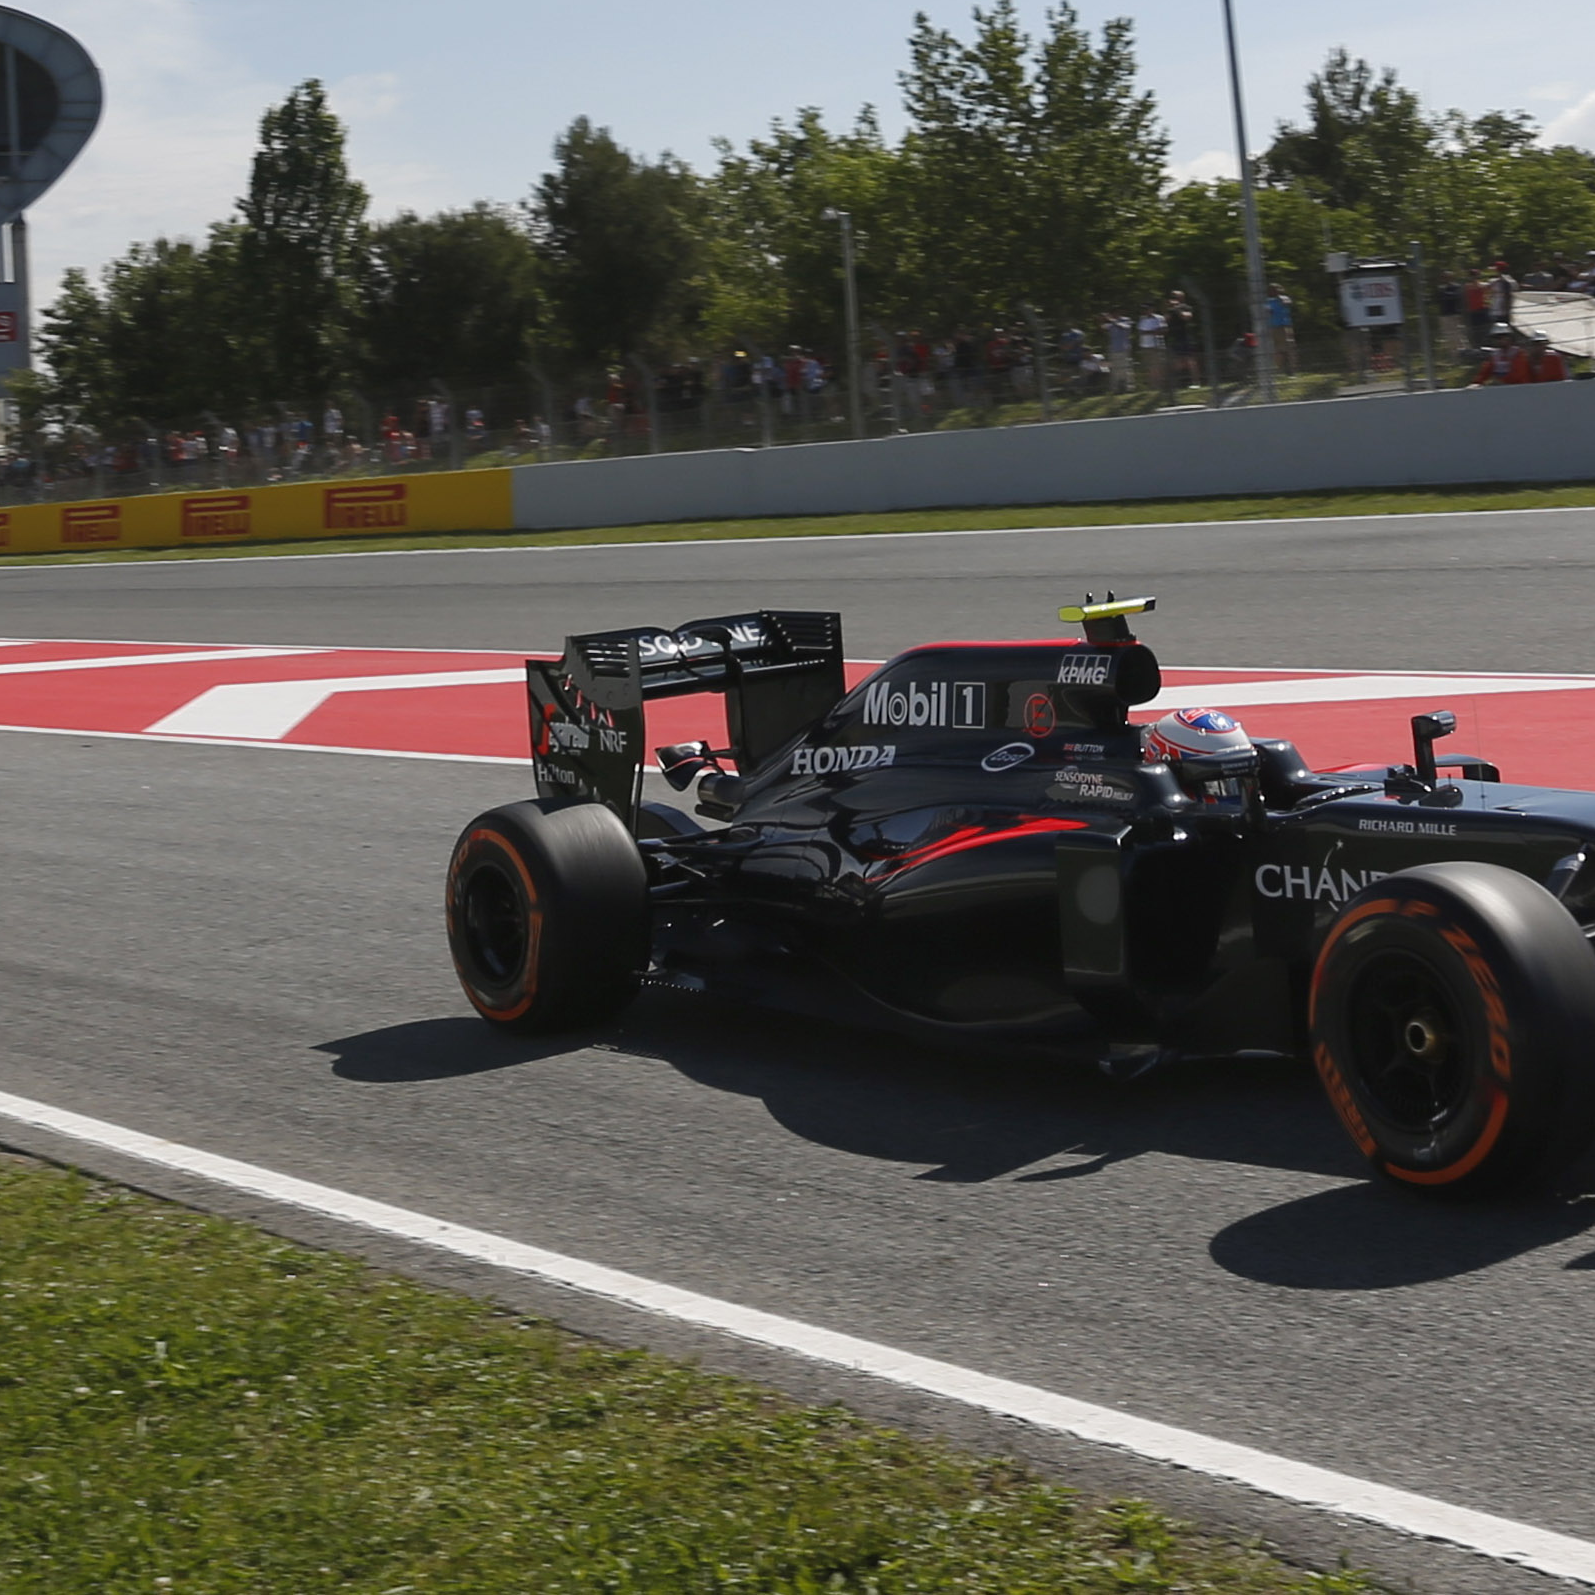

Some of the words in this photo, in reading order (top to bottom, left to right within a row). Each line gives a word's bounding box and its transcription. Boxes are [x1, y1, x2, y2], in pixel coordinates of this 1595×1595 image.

[1057, 666, 1107, 684] KPMG
[863, 681, 947, 727] Mobil
[1031, 699, 1048, 732] E
[599, 729, 627, 753] NRF
[1074, 743, 1105, 752] BUTTON
[790, 745, 897, 775] HONDA
[1054, 771, 1103, 785] SENSODYNE
[1079, 784, 1113, 798] RAPID
[1358, 819, 1414, 834] RICHARD
[1418, 822, 1458, 836] MILLE
